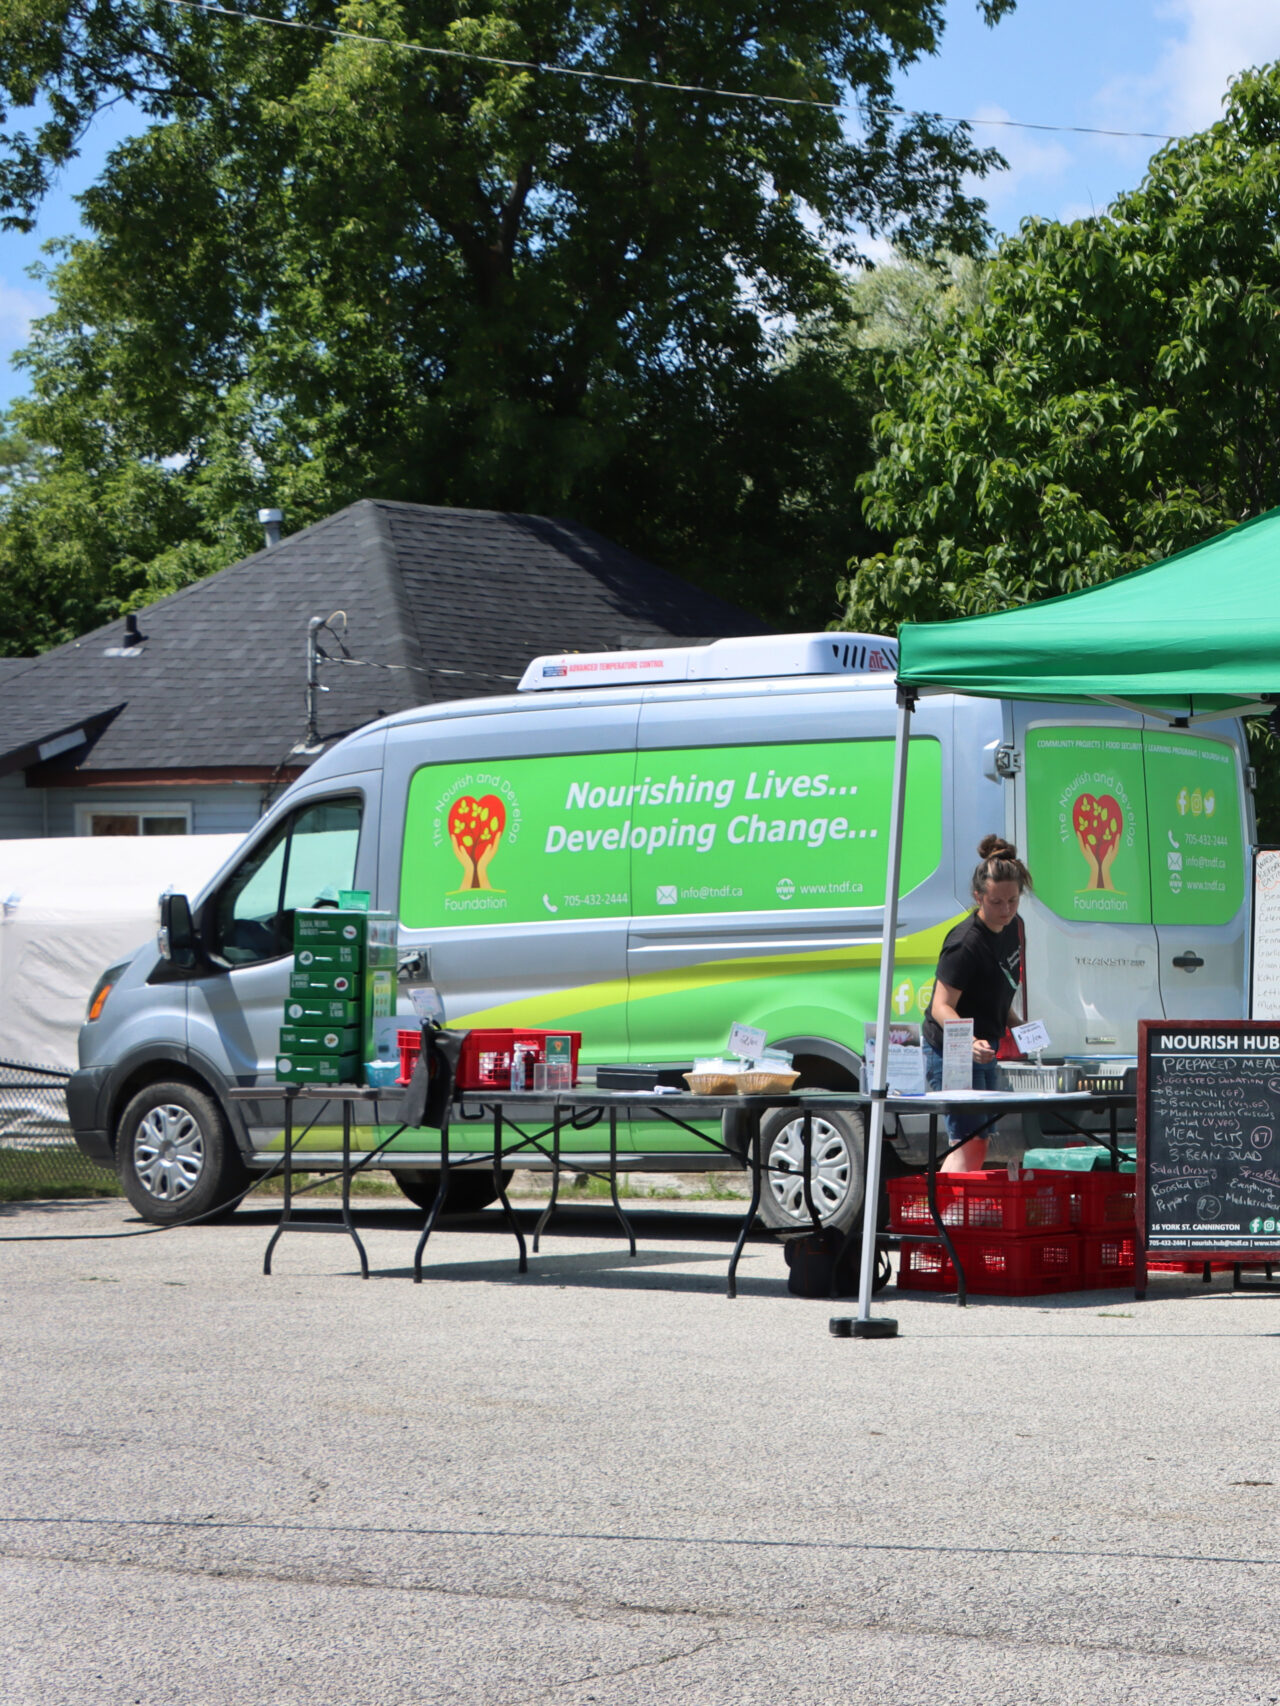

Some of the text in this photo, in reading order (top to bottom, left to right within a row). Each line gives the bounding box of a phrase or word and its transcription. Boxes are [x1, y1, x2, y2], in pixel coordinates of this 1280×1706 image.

[565, 770, 858, 810] Nourishing Lives...
[433, 773, 523, 847] The Nourish and Develop
[1059, 772, 1136, 847] The Nourish and Develop
[544, 814, 878, 855] Developing Change...
[1184, 833, 1228, 845] 705-432-2444
[1185, 856, 1226, 869] info@tndf.ca
[563, 893, 628, 907] 705-432-2444
[681, 886, 743, 900] info@tndf.ca
[800, 882, 864, 895] www.tndf.ca
[444, 897, 507, 911] Foundation
[1073, 896, 1128, 910] Foundation
[1075, 957, 1130, 967] TRANSIT
[1160, 1035, 1280, 1050] NOURISH HUB
[1162, 1057, 1237, 1073] PREPARED
[1157, 1075, 1216, 1085] SUGGESTED
[1165, 1085, 1245, 1099] Beef Chili (GF)
[1169, 1098, 1199, 1108] Bean
[1201, 1099, 1226, 1110] Chili
[1165, 1126, 1205, 1140] MEAL
[1213, 1131, 1243, 1148] KITS
[1150, 1162, 1180, 1175] Salad
[1151, 1180, 1193, 1197] Roasted
[1156, 1193, 1191, 1212] Pepper
[1151, 1223, 1241, 1231] 16 YORK ST. CANNINGTON
